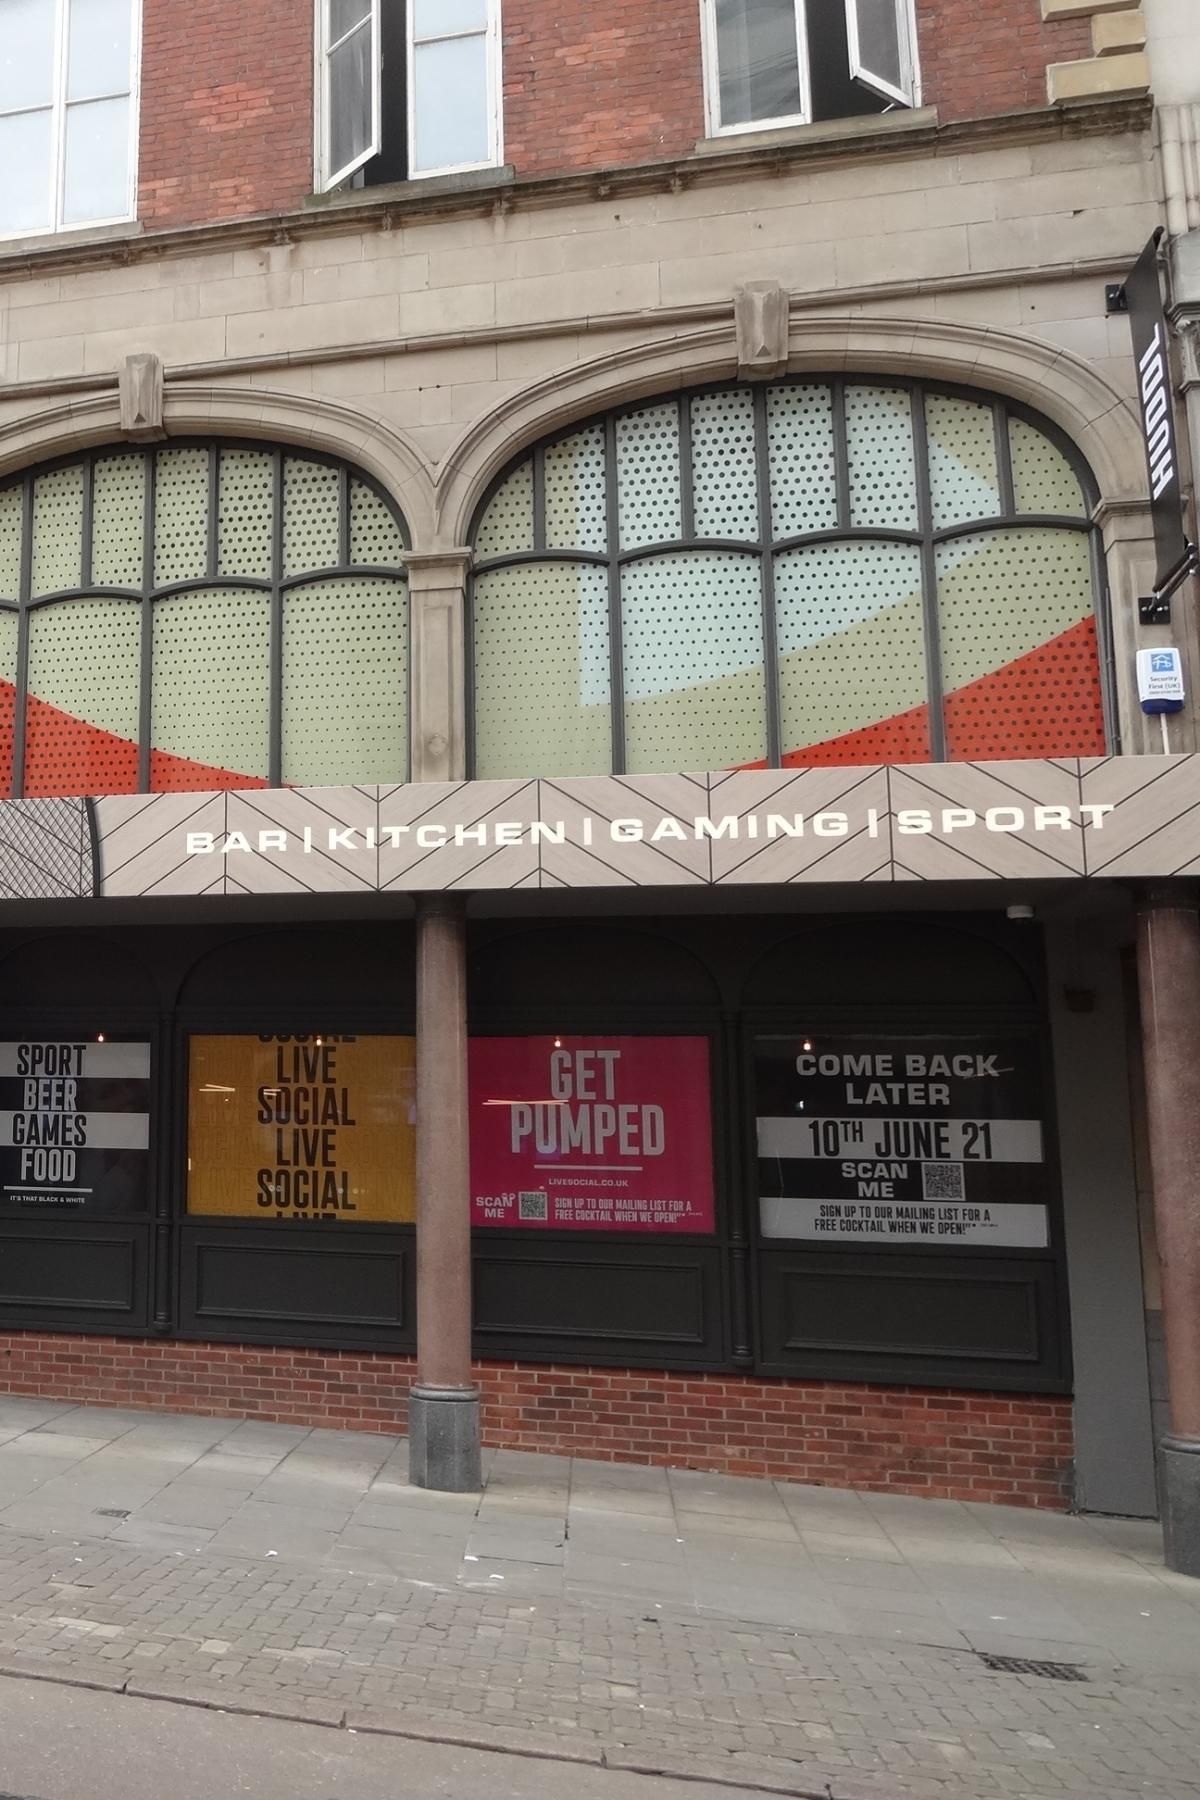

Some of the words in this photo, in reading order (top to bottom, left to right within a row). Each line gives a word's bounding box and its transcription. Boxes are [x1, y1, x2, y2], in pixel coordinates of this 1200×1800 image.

[1139, 322, 1174, 501] HUDDL
[186, 830, 287, 854] BAR
[328, 821, 566, 850] KITCHEN
[610, 811, 849, 842] GAMING
[897, 804, 1114, 835] SPORT
[16, 1044, 87, 1076] SPORT
[277, 1046, 337, 1084] LIVE
[551, 1049, 621, 1100] GET
[795, 1054, 893, 1077] COME
[905, 1054, 999, 1078] BACK
[23, 1079, 77, 1111] BEER
[257, 1086, 356, 1126] SOCIAL
[846, 1082, 950, 1106] LATER
[12, 1113, 87, 1146] GAMES
[511, 1102, 665, 1156] PUMPED
[808, 1120, 864, 1157] 10TH
[875, 1121, 951, 1159] JUNE
[961, 1122, 992, 1160] 21
[276, 1128, 337, 1167] LIVE
[20, 1148, 76, 1182] FOOD
[841, 1162, 908, 1179] SCAN
[257, 1168, 356, 1210] SOCIAL
[476, 1195, 513, 1208] SCAN
[554, 1197, 572, 1209] SIGN
[574, 1198, 584, 1209] UP
[587, 1198, 596, 1210] TO
[598, 1198, 613, 1210] OUR
[615, 1199, 647, 1211] MAILING
[650, 1200, 667, 1211] LIST
[668, 1200, 684, 1212] FOR
[686, 1201, 692, 1212] A
[857, 1181, 894, 1198] ME
[484, 1207, 505, 1219] ME
[555, 1209, 573, 1220] FREE
[575, 1210, 612, 1222] COCKTAIL
[614, 1211, 638, 1223] WHEN
[639, 1211, 652, 1223] WE
[814, 1218, 837, 1231] FREE
[839, 1219, 885, 1233] COCKTAIL
[888, 1220, 917, 1234] WHEN
[919, 1221, 935, 1235] WE
[819, 1204, 841, 1218] SIGN
[844, 1205, 857, 1218] UP
[860, 1205, 871, 1218] TO
[874, 1206, 893, 1219] OUR
[896, 1206, 935, 1220] MAILING
[938, 1207, 959, 1221] LIST
[962, 1208, 980, 1221] FOR
[983, 1209, 991, 1222] A
